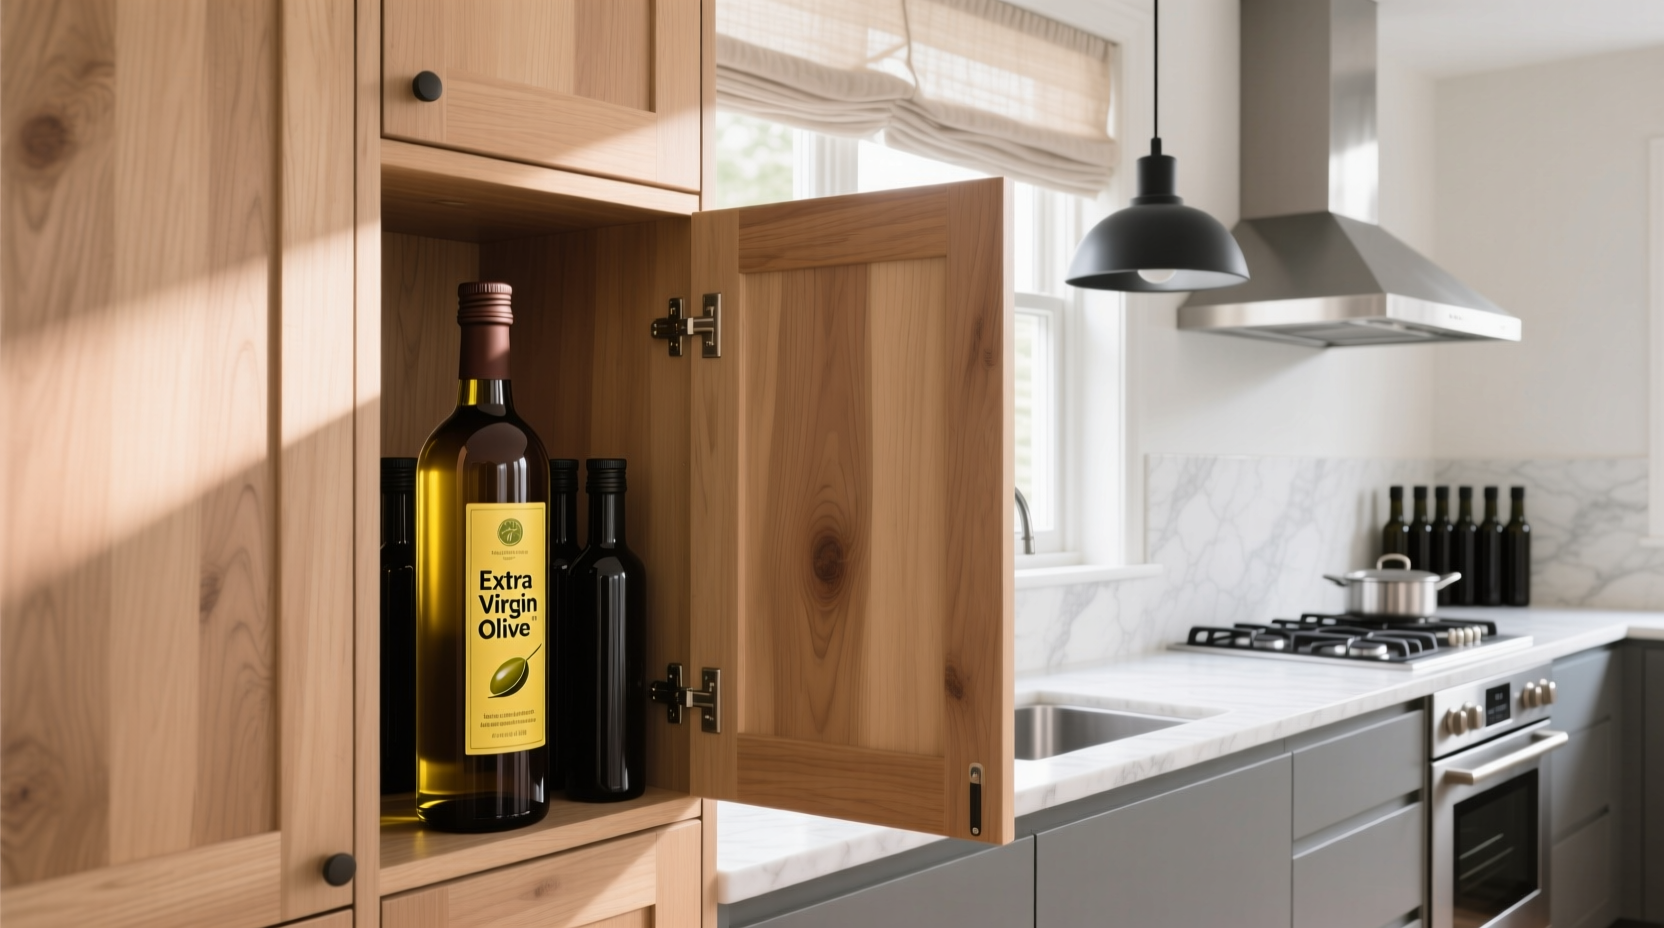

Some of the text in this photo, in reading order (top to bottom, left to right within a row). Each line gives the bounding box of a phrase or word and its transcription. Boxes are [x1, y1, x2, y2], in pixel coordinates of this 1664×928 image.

[480, 570, 532, 590] Extra
[478, 593, 537, 619] Virgin
[478, 618, 530, 640] Olive
